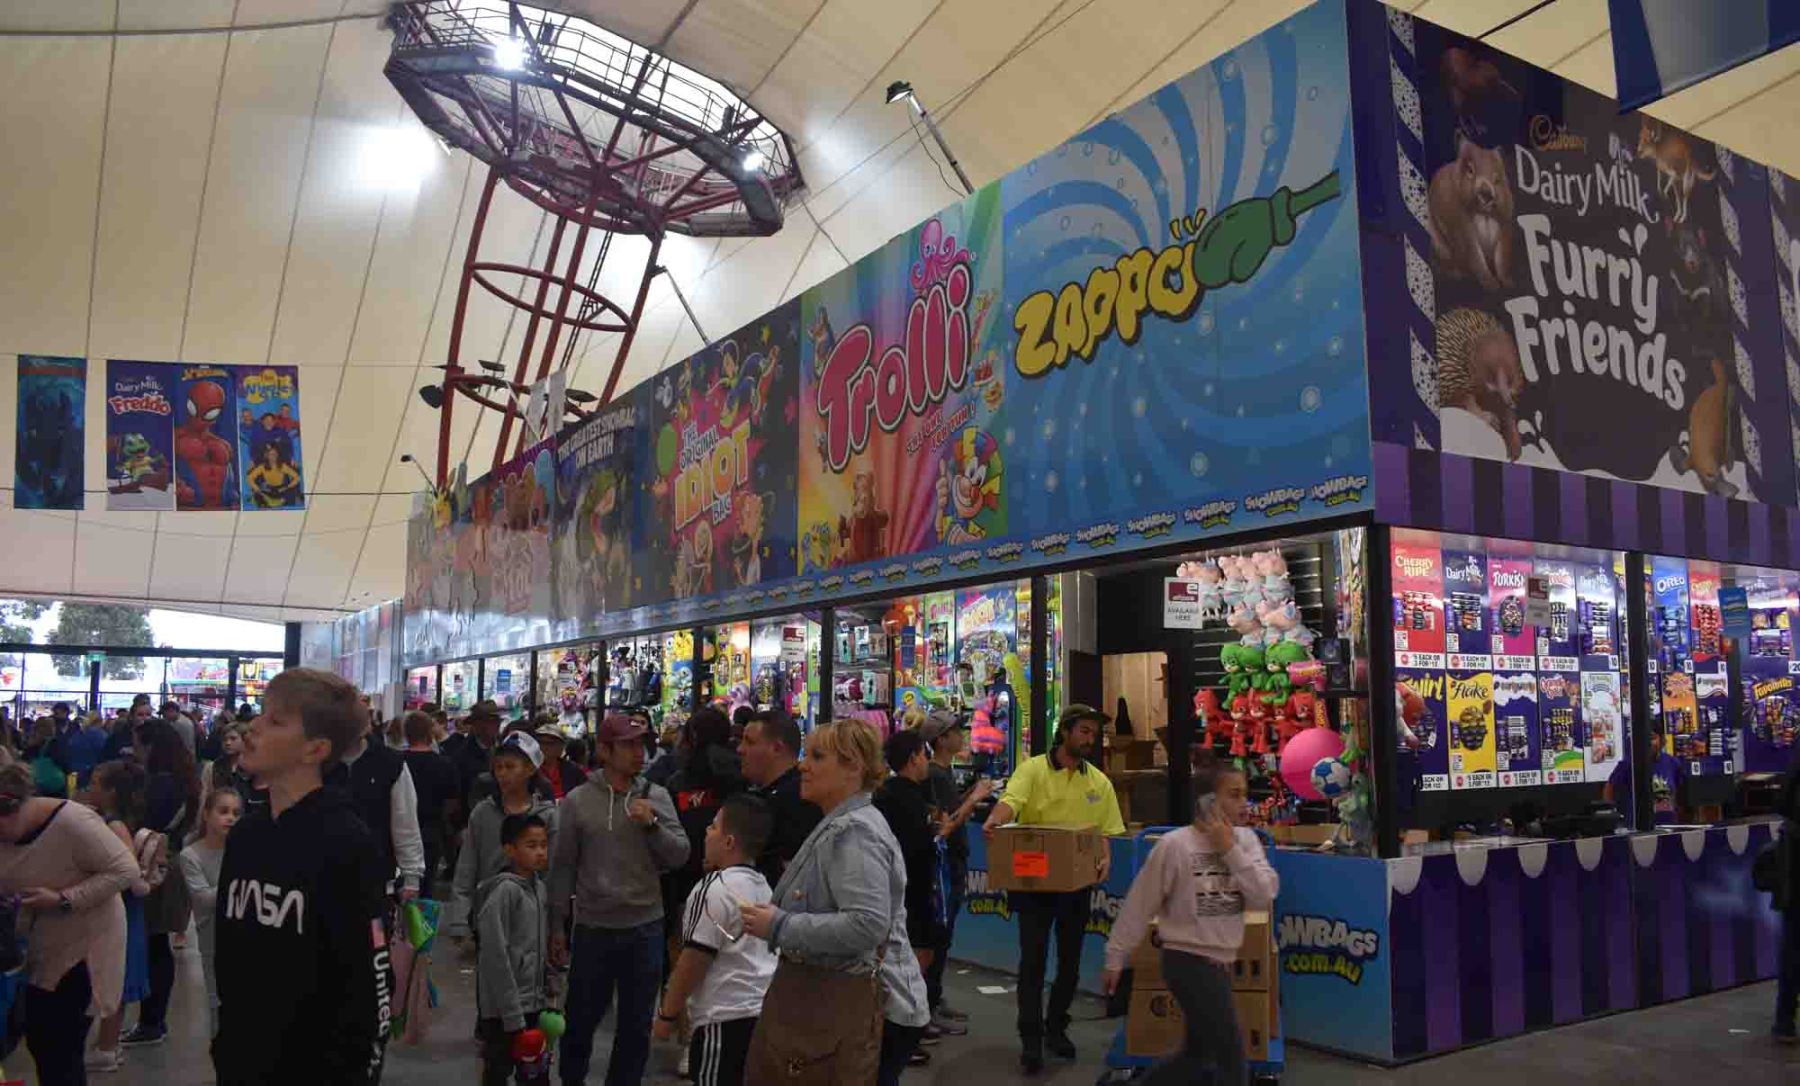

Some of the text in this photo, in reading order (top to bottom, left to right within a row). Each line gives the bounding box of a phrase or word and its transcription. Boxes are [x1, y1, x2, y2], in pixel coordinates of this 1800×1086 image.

[1515, 144, 1659, 223] Dairy Milk
[1517, 214, 1658, 334] Furry
[1504, 297, 1685, 411] Friends
[818, 264, 971, 472] Trolli
[115, 379, 163, 393] Dairy Milk
[108, 393, 172, 415] Freddo
[674, 418, 750, 532] IDIOT
[1395, 554, 1434, 570] CHERRY
[1404, 566, 1430, 577] RIPE
[1445, 566, 1465, 580] Dairy
[1656, 576, 1685, 592] OREO
[1454, 682, 1489, 700] flake
[226, 878, 304, 935] NASA
